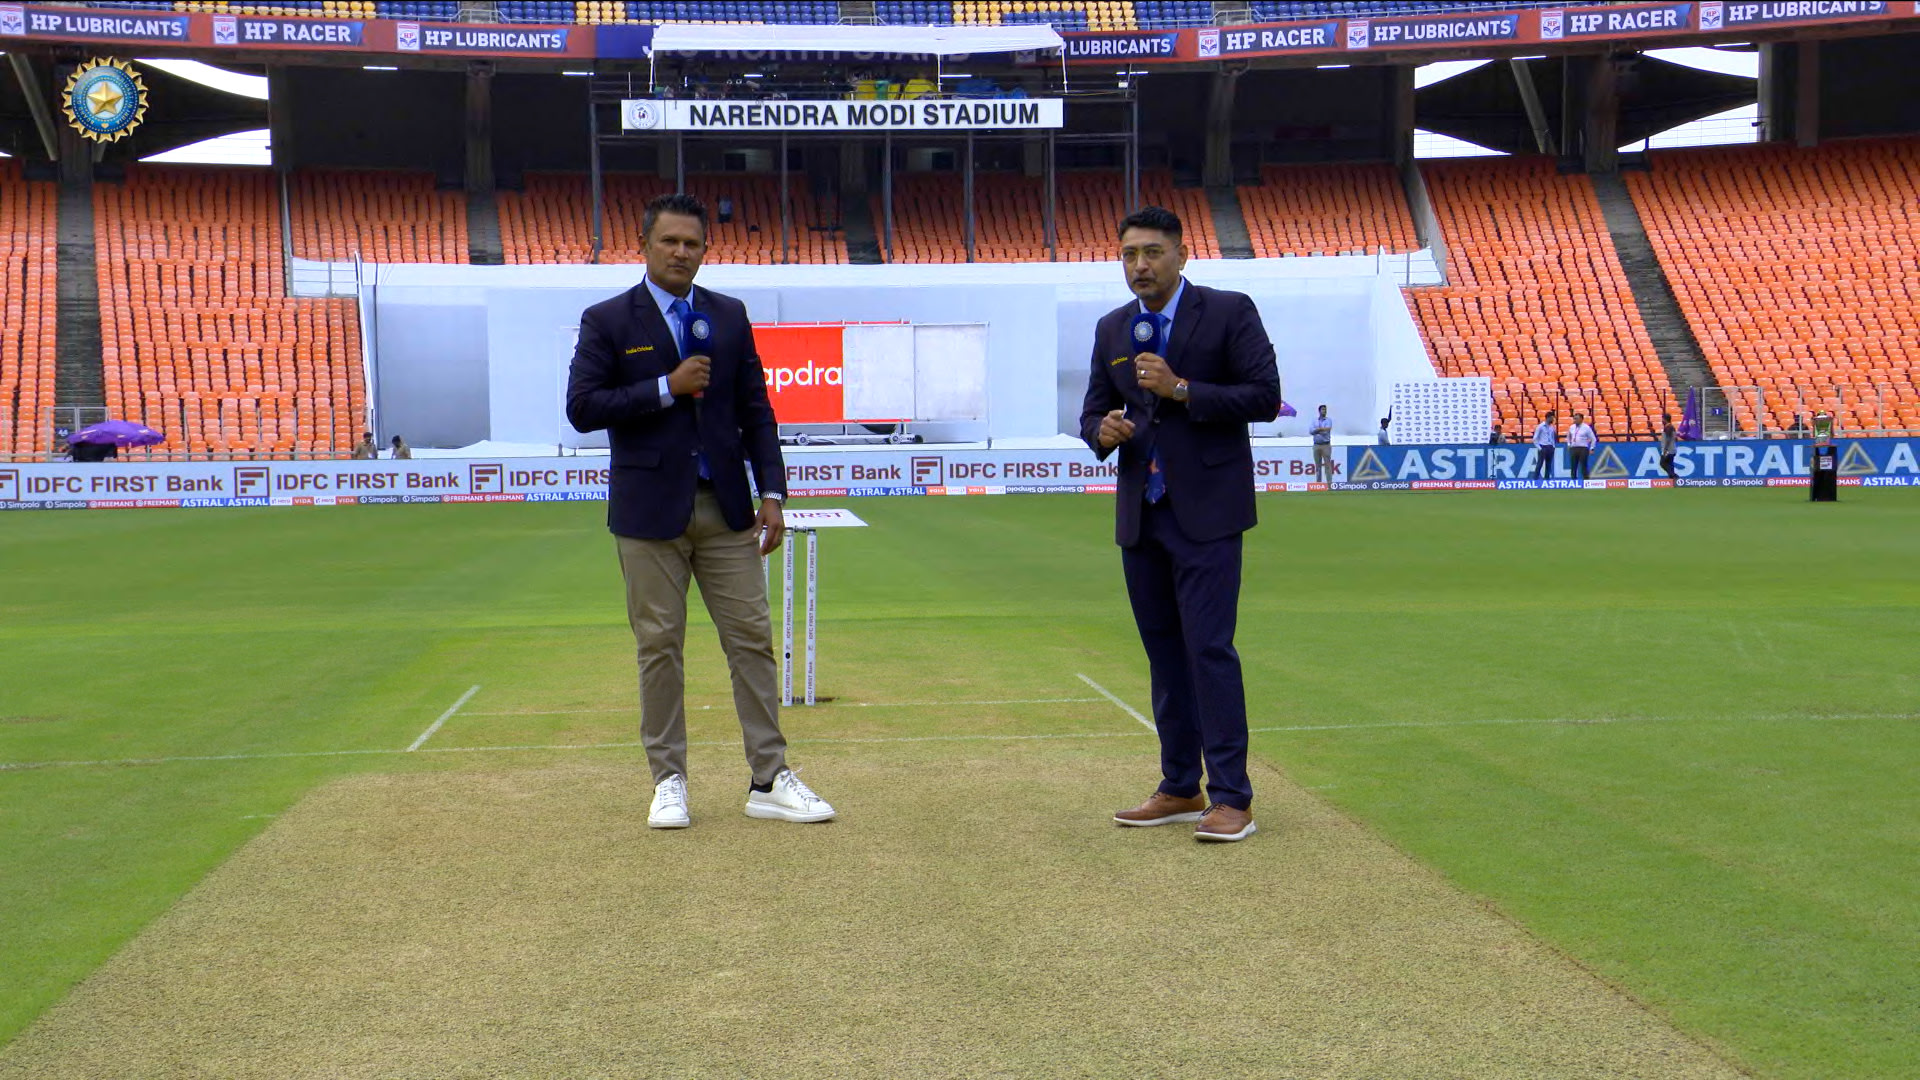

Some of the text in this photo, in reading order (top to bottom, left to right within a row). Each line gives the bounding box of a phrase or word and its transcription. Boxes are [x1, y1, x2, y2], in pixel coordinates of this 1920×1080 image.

[1729, 0, 1882, 21] HP LUBRICANTS
[31, 14, 183, 36] HP LUBRICANTS
[1571, 9, 1677, 33] HP RACER
[244, 22, 352, 42] HP RACER
[1374, 19, 1511, 42] HP LUBRICANTS
[425, 31, 562, 48] HP LUBRICANTS
[1226, 28, 1325, 50] HP RACER
[1070, 39, 1171, 56] LUBRICANTS
[690, 103, 1039, 126] NARENDRA MODI STADIUM
[1290, 459, 1341, 476] Bak
[1397, 448, 1572, 479] ASTRAL
[1635, 445, 1810, 477] ASTRAL
[510, 470, 558, 486] IDFC
[787, 465, 901, 481] FIRST Bank
[949, 462, 1118, 479] IDFC FIRST Bank
[27, 475, 224, 493] IDFC FIRST Bank
[276, 472, 459, 490] IDFC FIRST Bank
[1339, 482, 1367, 490] Simpolo
[1380, 482, 1409, 490] Simpolo
[1498, 480, 1538, 489] ASTRAL
[1541, 479, 1581, 488] ASTRAL
[1685, 479, 1717, 487] Simpolo
[1732, 478, 1763, 487] Simpolo
[1863, 476, 1908, 486] ASTRAL
[526, 493, 564, 501] ASTRAL
[567, 492, 605, 500] ASTRAL
[848, 488, 886, 496] ASTRAL
[888, 487, 925, 496] ASTRAL
[7, 501, 40, 509] Simpolo
[54, 501, 87, 509] Simpolo
[182, 498, 224, 507] ASTRAL
[228, 497, 268, 506] ASTRAL
[368, 496, 398, 504] Simpolo
